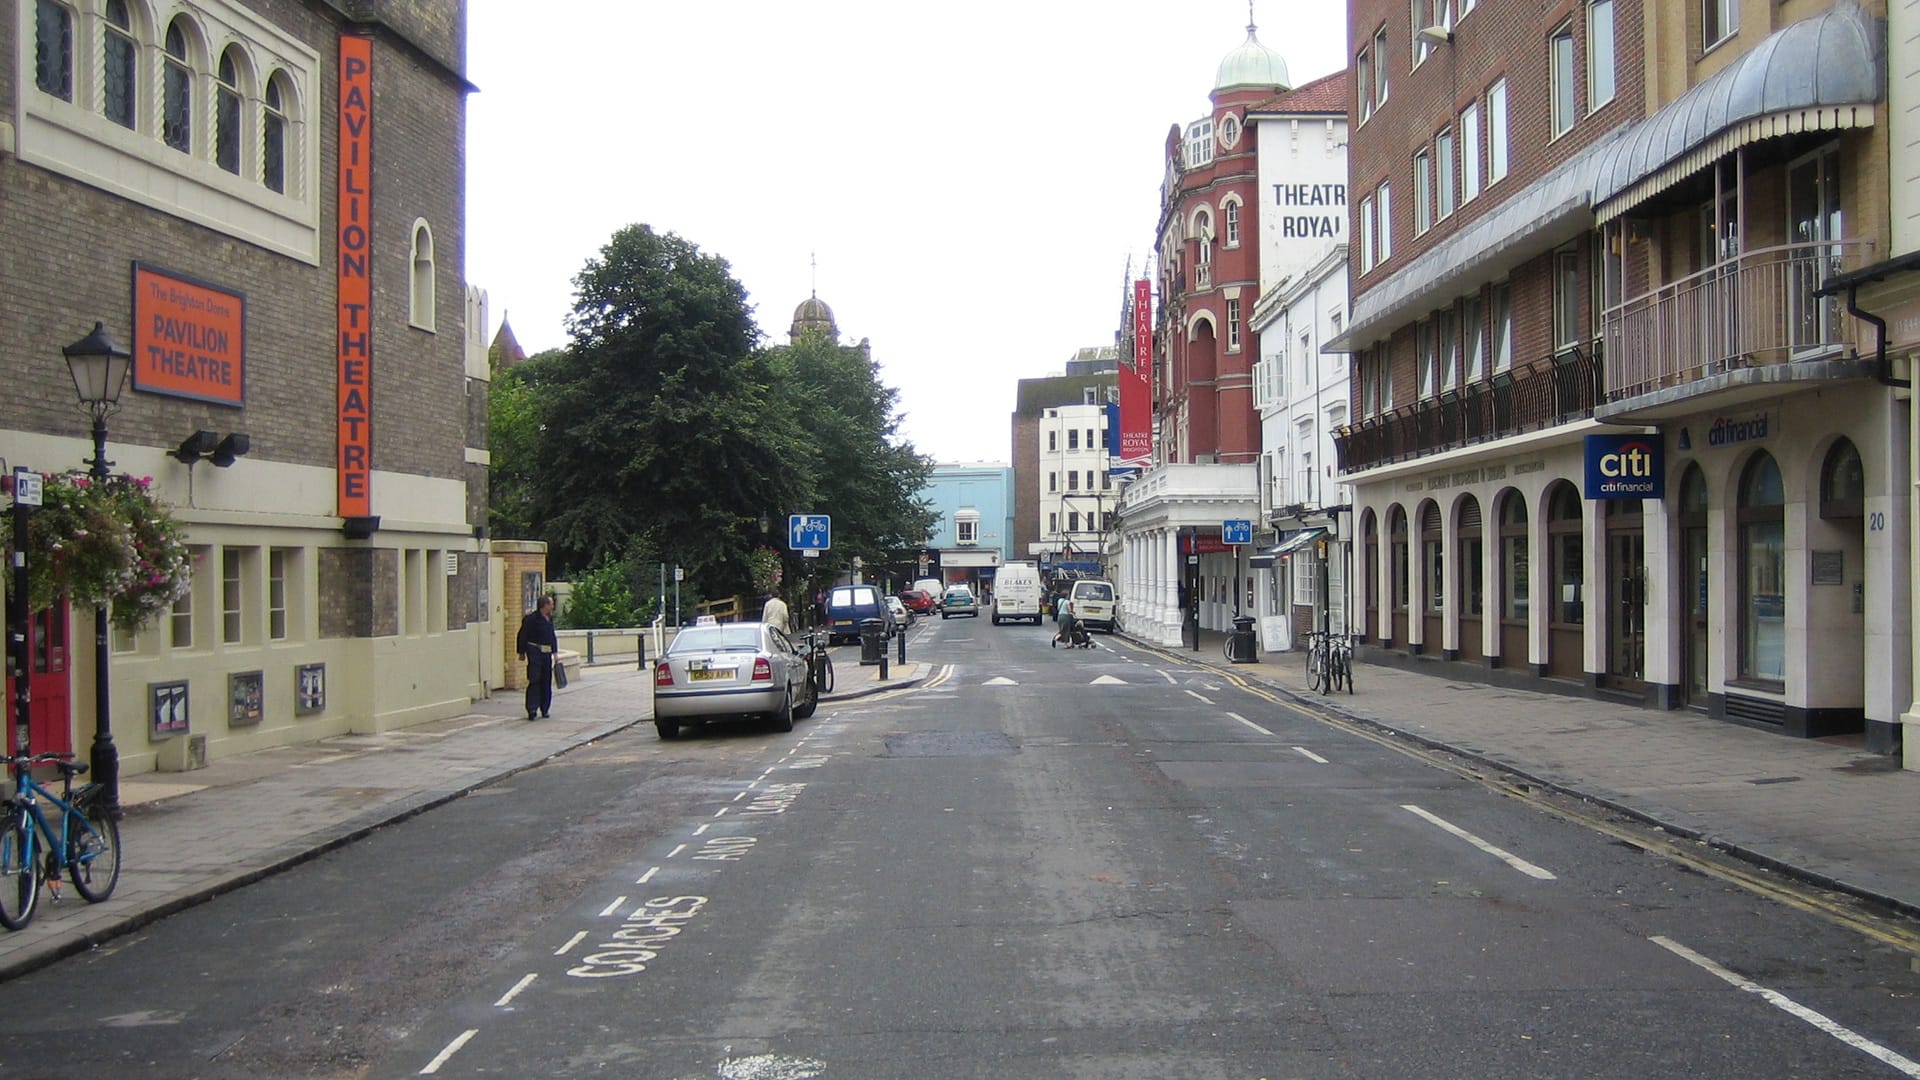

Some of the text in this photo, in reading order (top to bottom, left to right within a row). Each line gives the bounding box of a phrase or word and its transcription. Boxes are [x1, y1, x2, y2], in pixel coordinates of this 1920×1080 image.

[1272, 184, 1346, 206] THEATR
[342, 56, 367, 498] PAVILION THEATRE
[150, 282, 230, 318] The Brighton Dome
[153, 313, 228, 355] PAVILION
[147, 344, 232, 387] THEATRE
[1122, 438, 1149, 447] ROYAL
[1600, 448, 1650, 477] citi
[1870, 512, 1885, 531] 20
[692, 836, 758, 861] AND
[566, 895, 709, 978] COACHES
